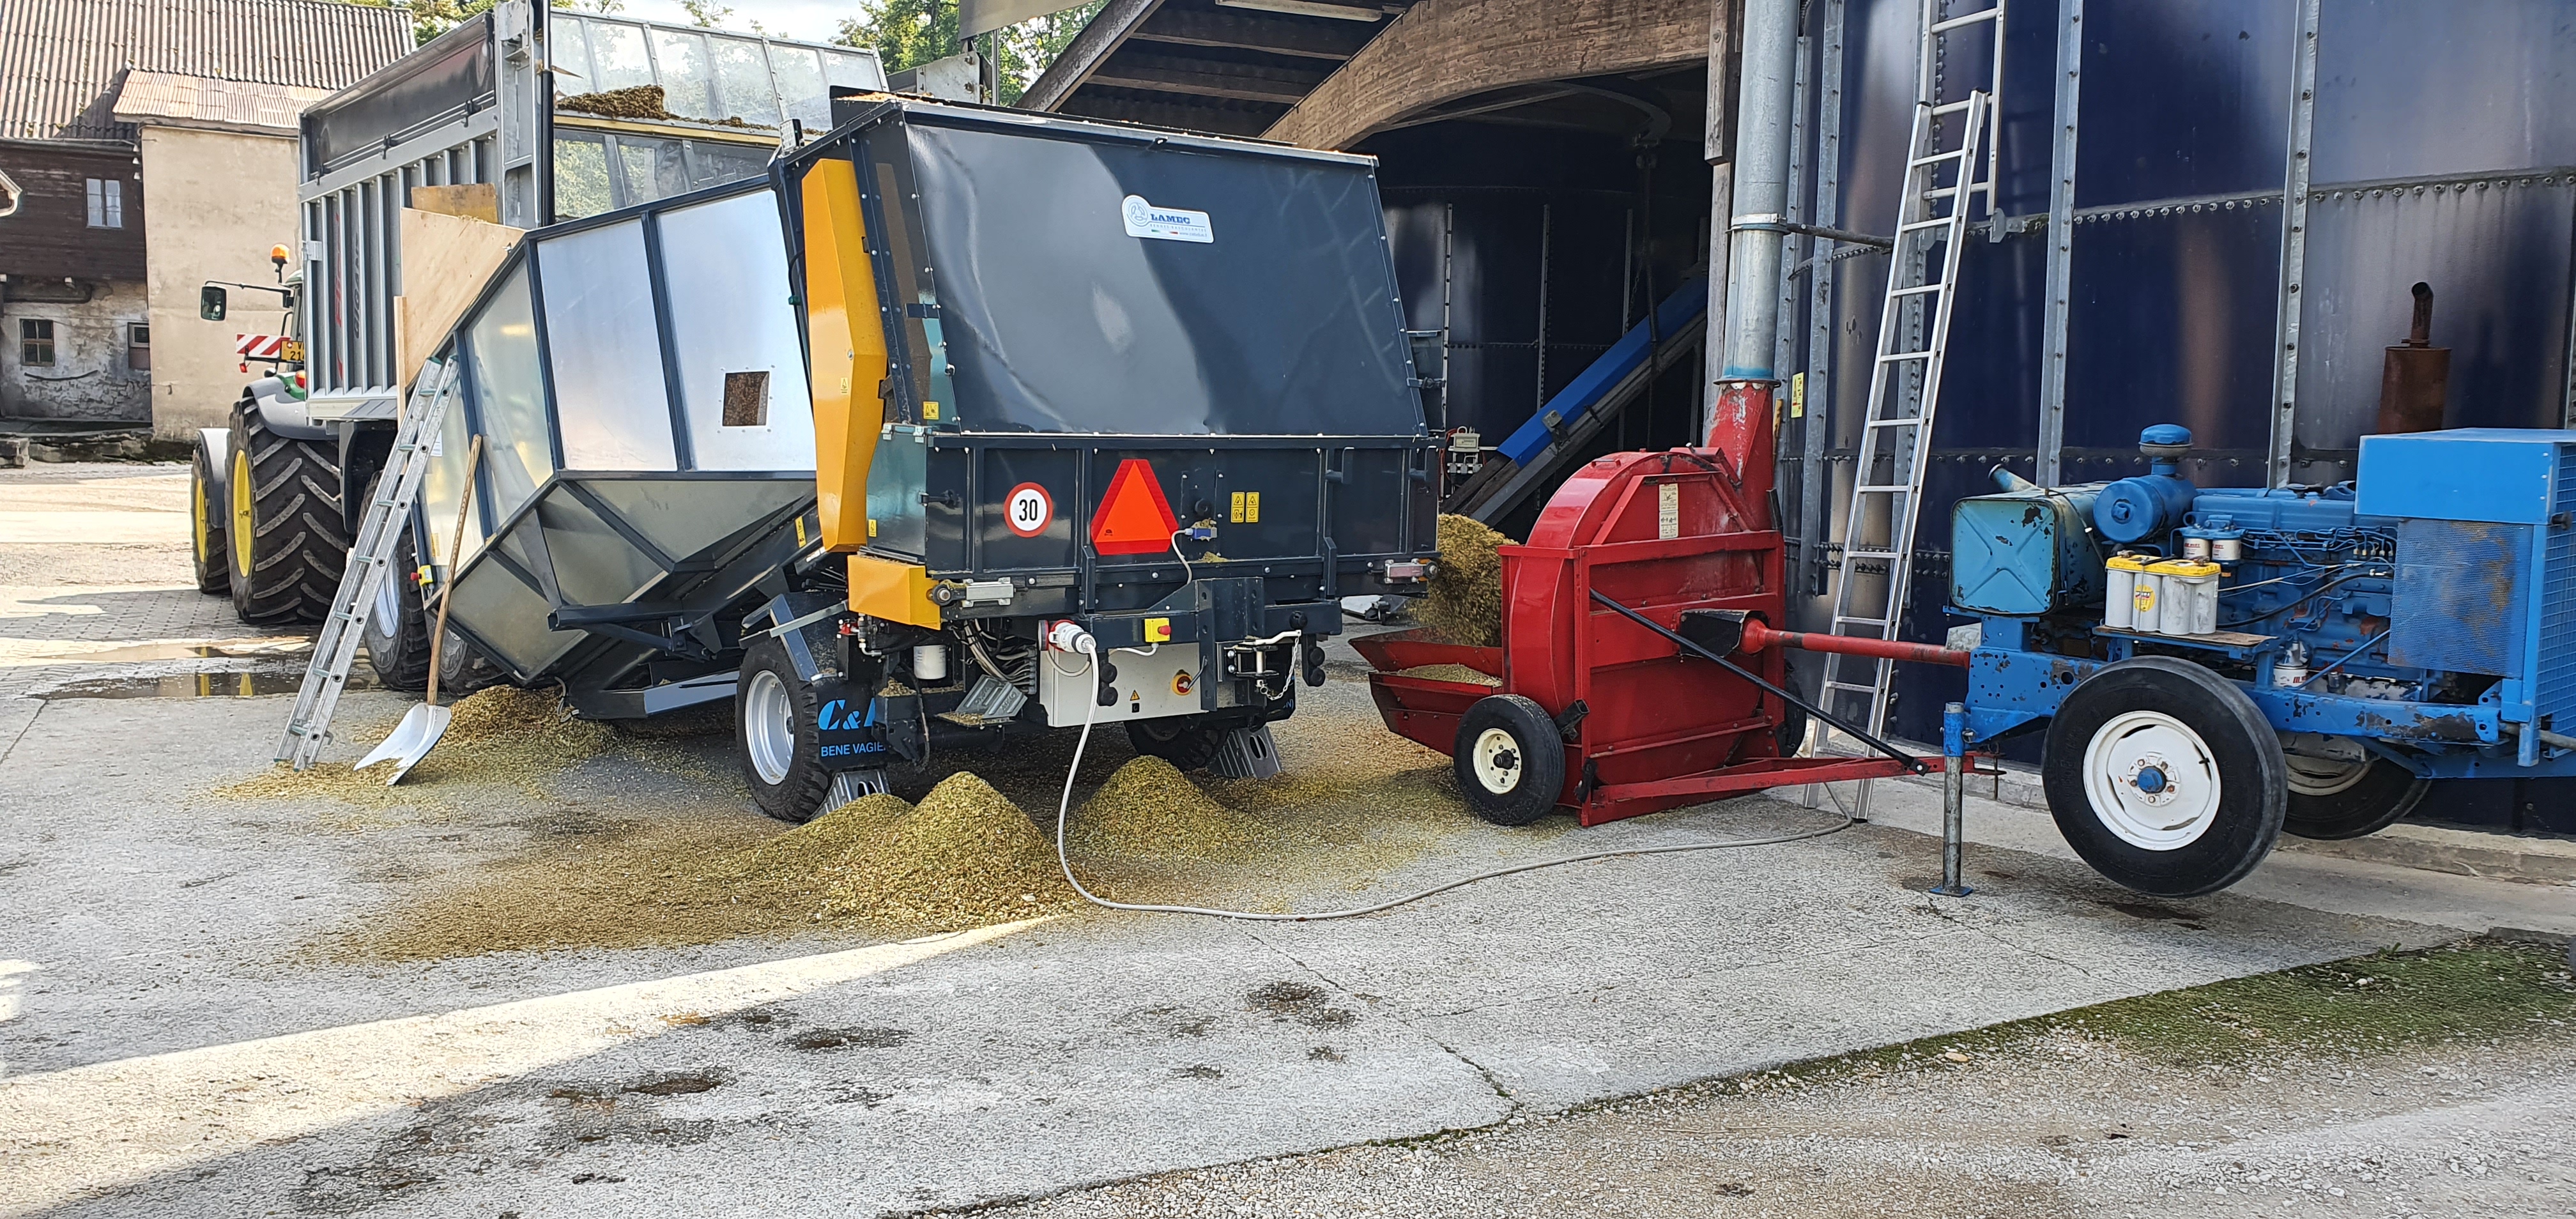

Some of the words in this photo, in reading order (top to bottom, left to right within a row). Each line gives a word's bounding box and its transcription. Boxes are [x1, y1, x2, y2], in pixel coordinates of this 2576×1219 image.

[1150, 213, 1190, 224] LAMEC
[298, 342, 304, 350] V
[1019, 499, 1038, 521] 30
[821, 744, 850, 757] BENE
[853, 742, 886, 754] VAGIE
